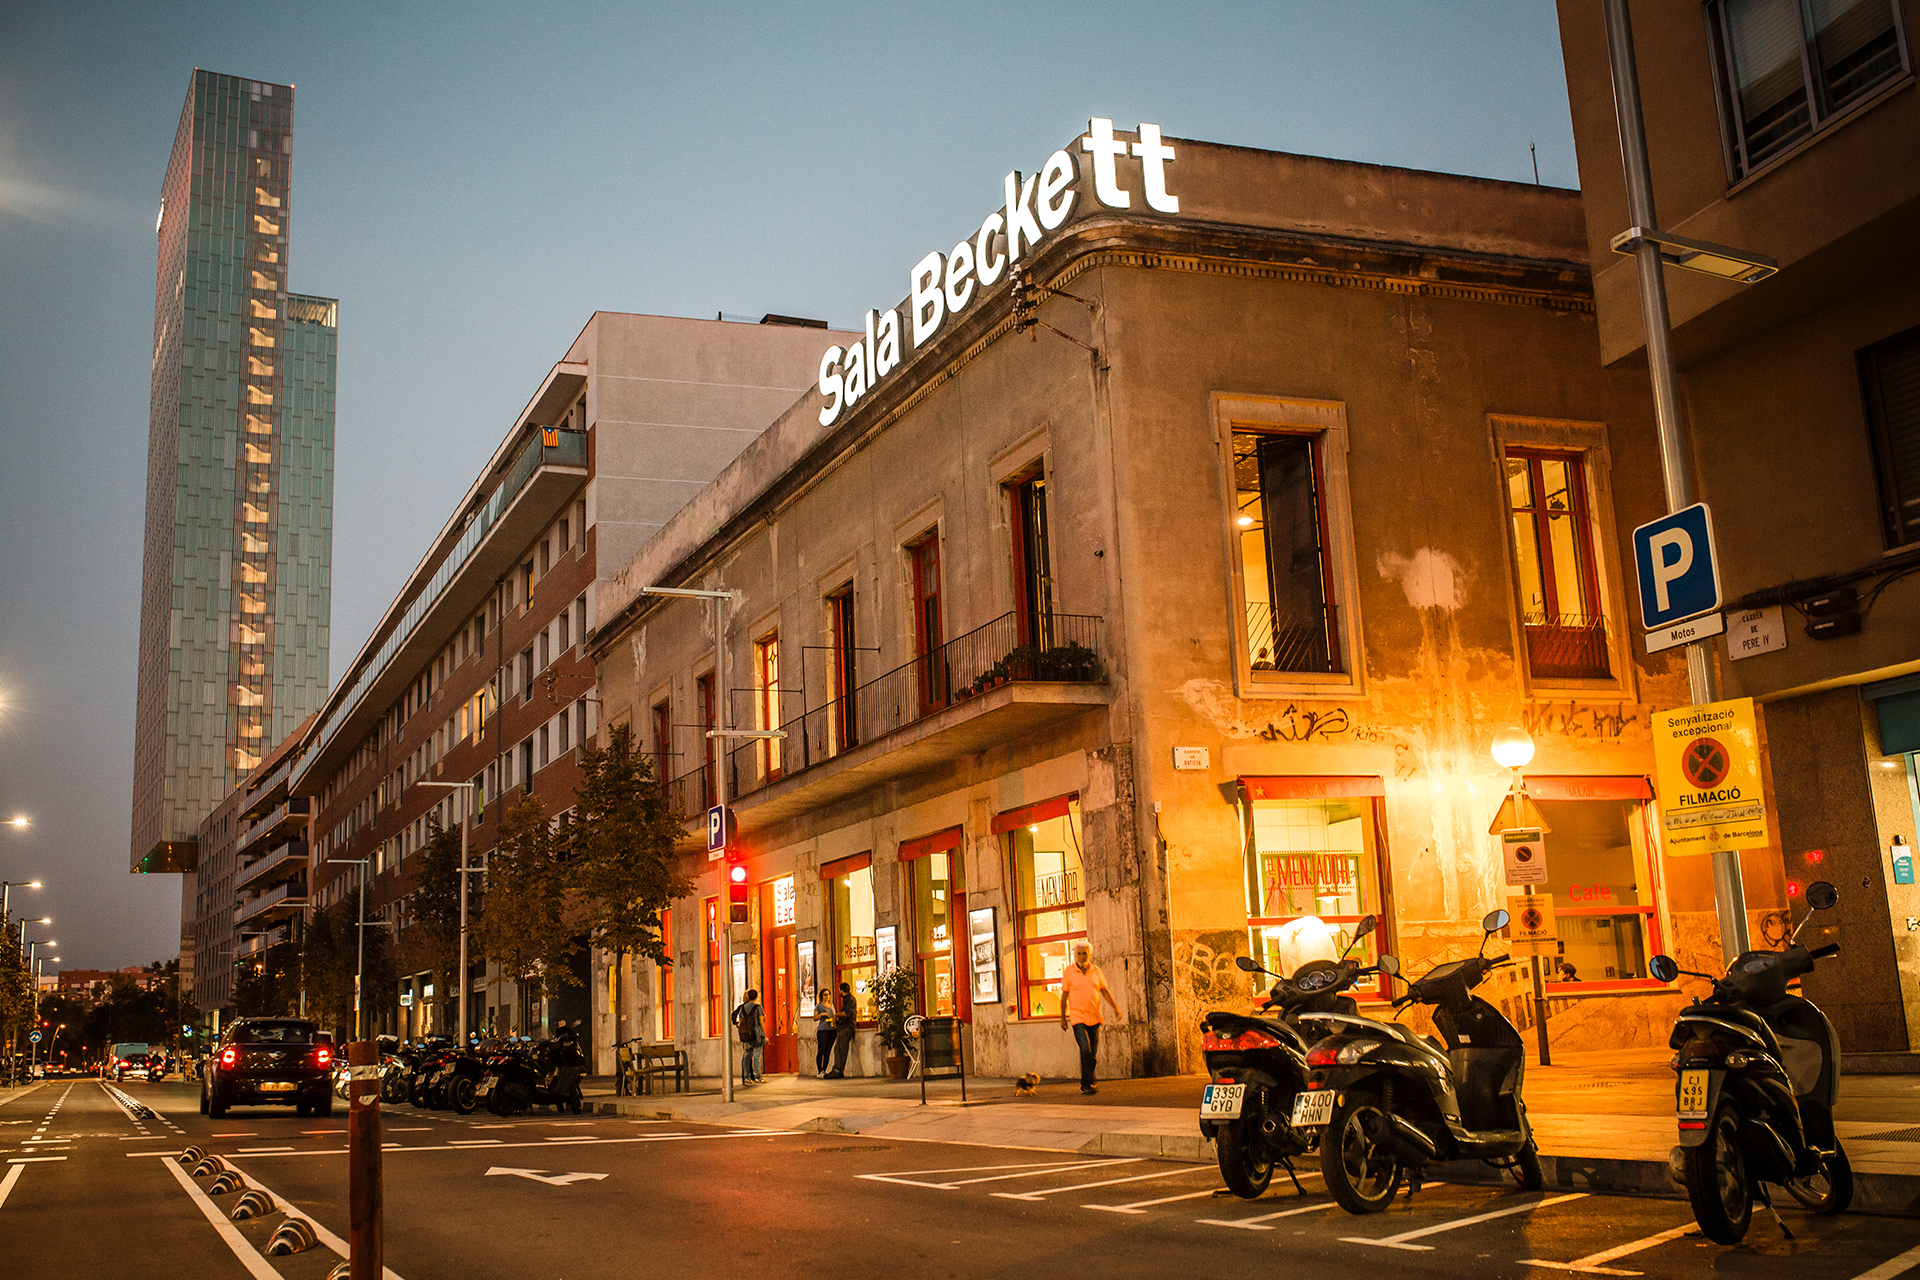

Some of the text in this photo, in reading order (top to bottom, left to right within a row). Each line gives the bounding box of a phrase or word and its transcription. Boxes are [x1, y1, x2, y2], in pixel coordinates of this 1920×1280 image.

[818, 117, 1180, 427] Sala Beckett
[1649, 526, 1694, 613] P
[1671, 627, 1696, 641] Motos
[1750, 625, 1759, 634] DE
[1742, 634, 1770, 650] PERE IV
[1668, 708, 1735, 728] Senyalització
[1672, 721, 1733, 739] excepcional
[1679, 785, 1741, 806] FILMACIÓ
[710, 811, 721, 846] P
[1669, 835, 1706, 845] Ajuntament
[1732, 829, 1763, 839] Barcelona
[1277, 854, 1352, 886] MENJADOR
[1213, 1086, 1242, 1099] 3390
[1211, 1100, 1233, 1112] GYD
[1303, 1093, 1333, 1109] 9400
[1684, 1097, 1703, 1106] BRJ
[1300, 1108, 1323, 1123] HHN
